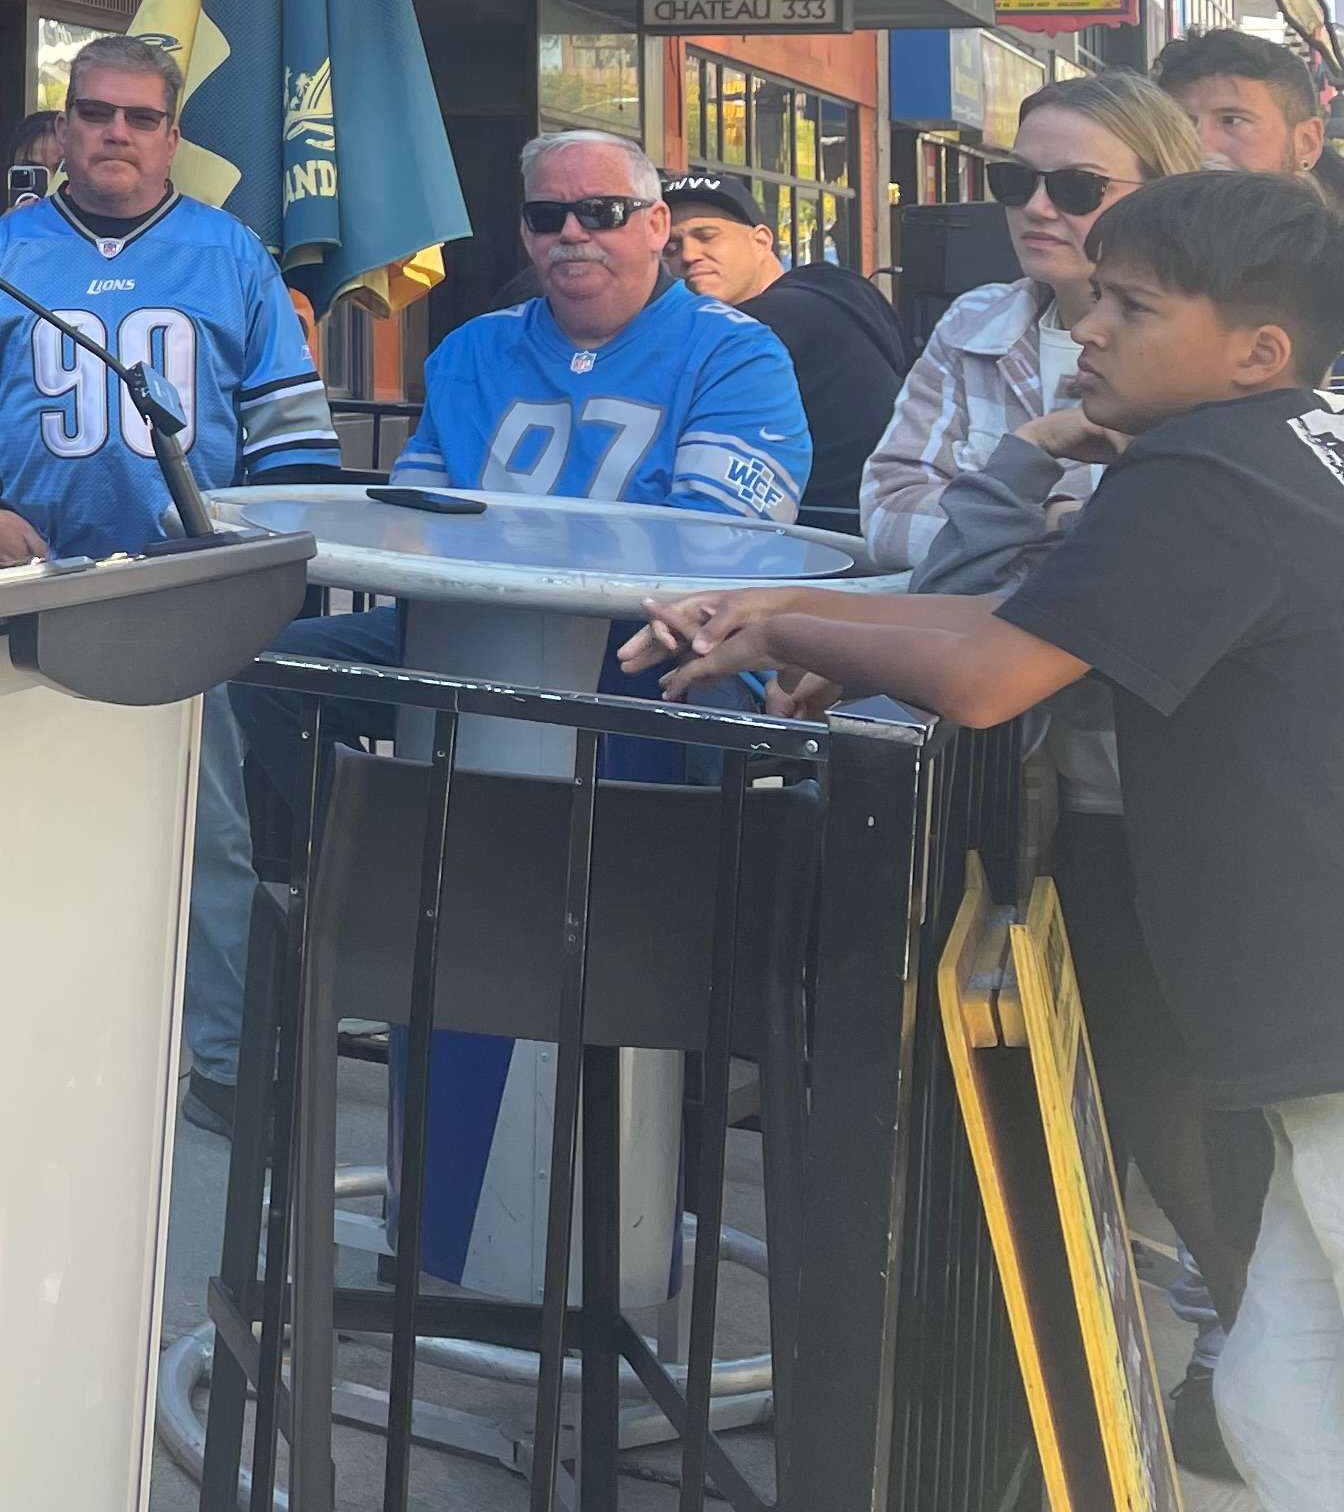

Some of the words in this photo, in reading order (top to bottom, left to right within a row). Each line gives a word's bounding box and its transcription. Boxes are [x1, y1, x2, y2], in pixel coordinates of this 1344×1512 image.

[87, 278, 136, 296] LIONS
[31, 306, 197, 460] 90
[727, 455, 785, 509] WCF
